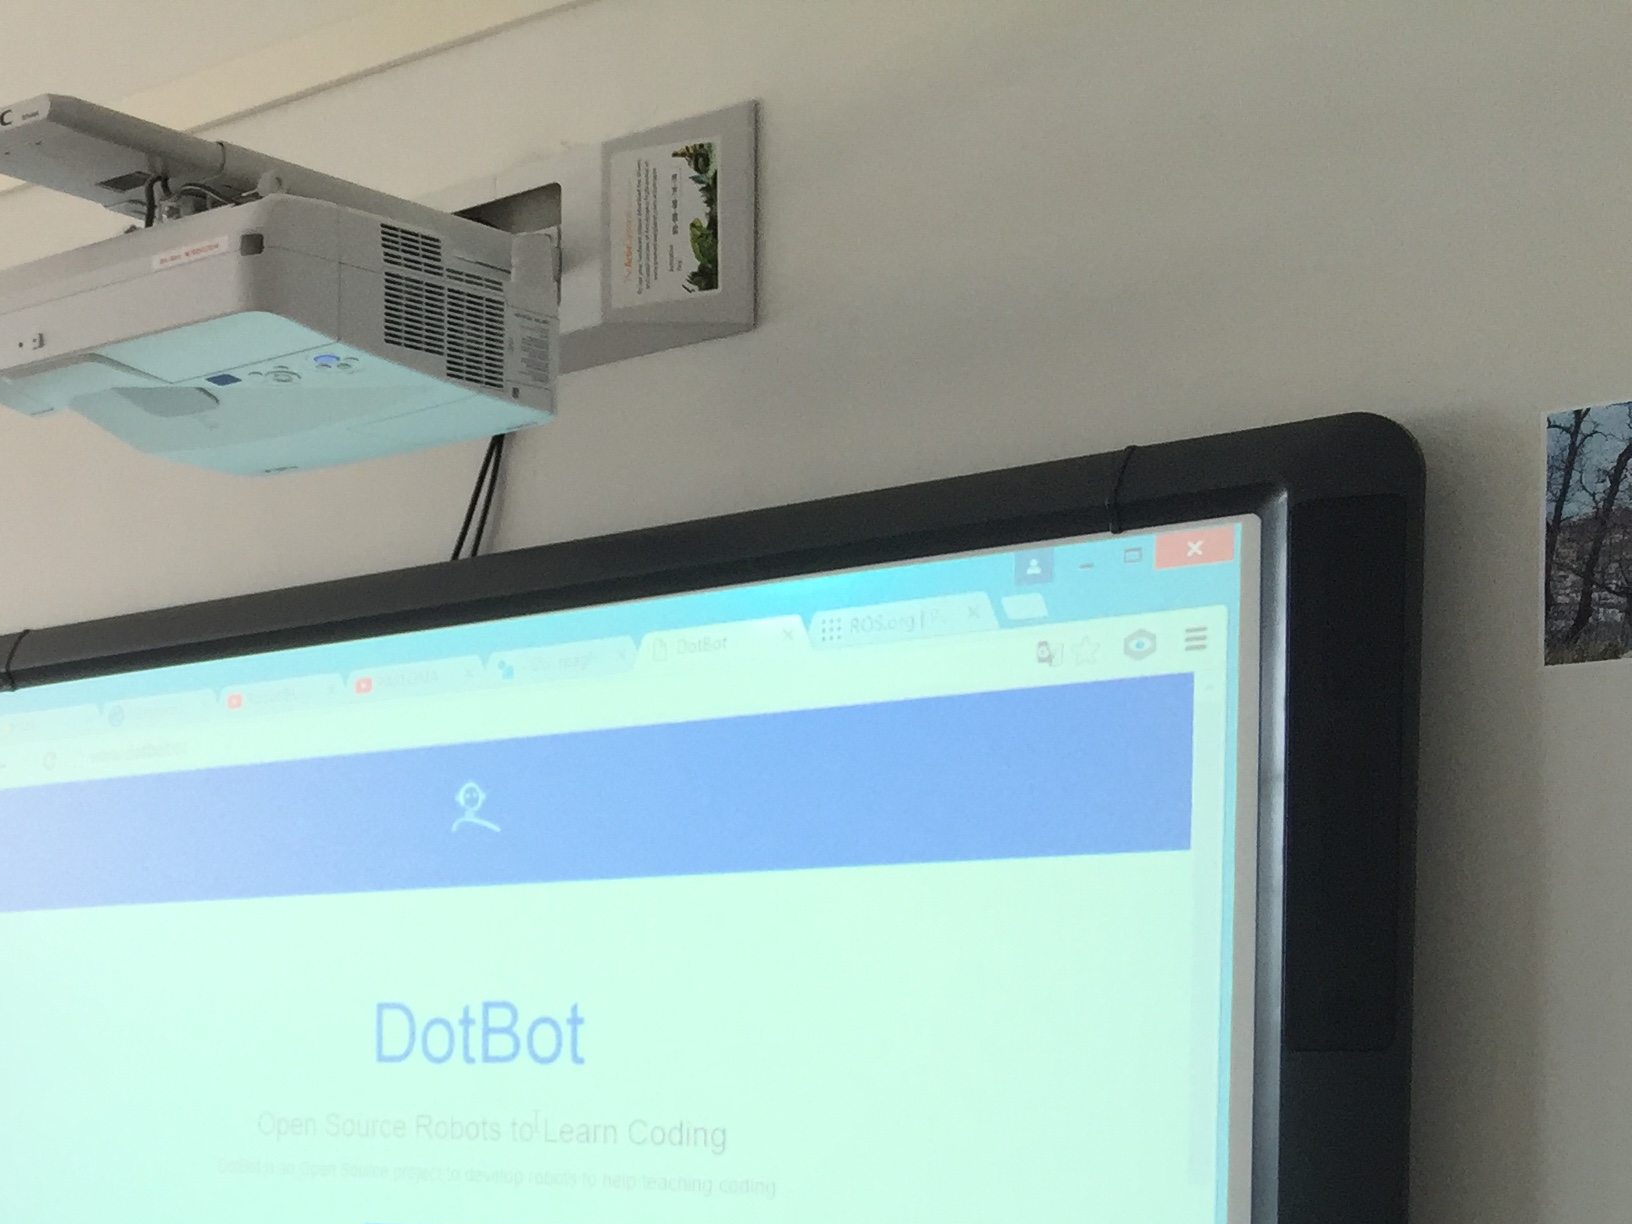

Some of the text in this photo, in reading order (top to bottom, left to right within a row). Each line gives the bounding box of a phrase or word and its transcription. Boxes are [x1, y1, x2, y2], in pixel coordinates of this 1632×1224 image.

[850, 615, 915, 635] ROS.org
[676, 636, 728, 656] DotBot
[375, 1001, 586, 1065] DotBot
[257, 1112, 728, 1154] Open Source Robots to Learn Coding
[299, 1161, 336, 1180] Open
[341, 1162, 388, 1179] Source
[393, 1165, 441, 1185] project
[447, 1166, 460, 1181] to
[464, 1167, 523, 1188] develop
[528, 1168, 577, 1187] robots
[582, 1171, 597, 1187] to
[603, 1170, 636, 1193] help
[641, 1173, 713, 1198] teaching
[719, 1177, 777, 1201] coding
